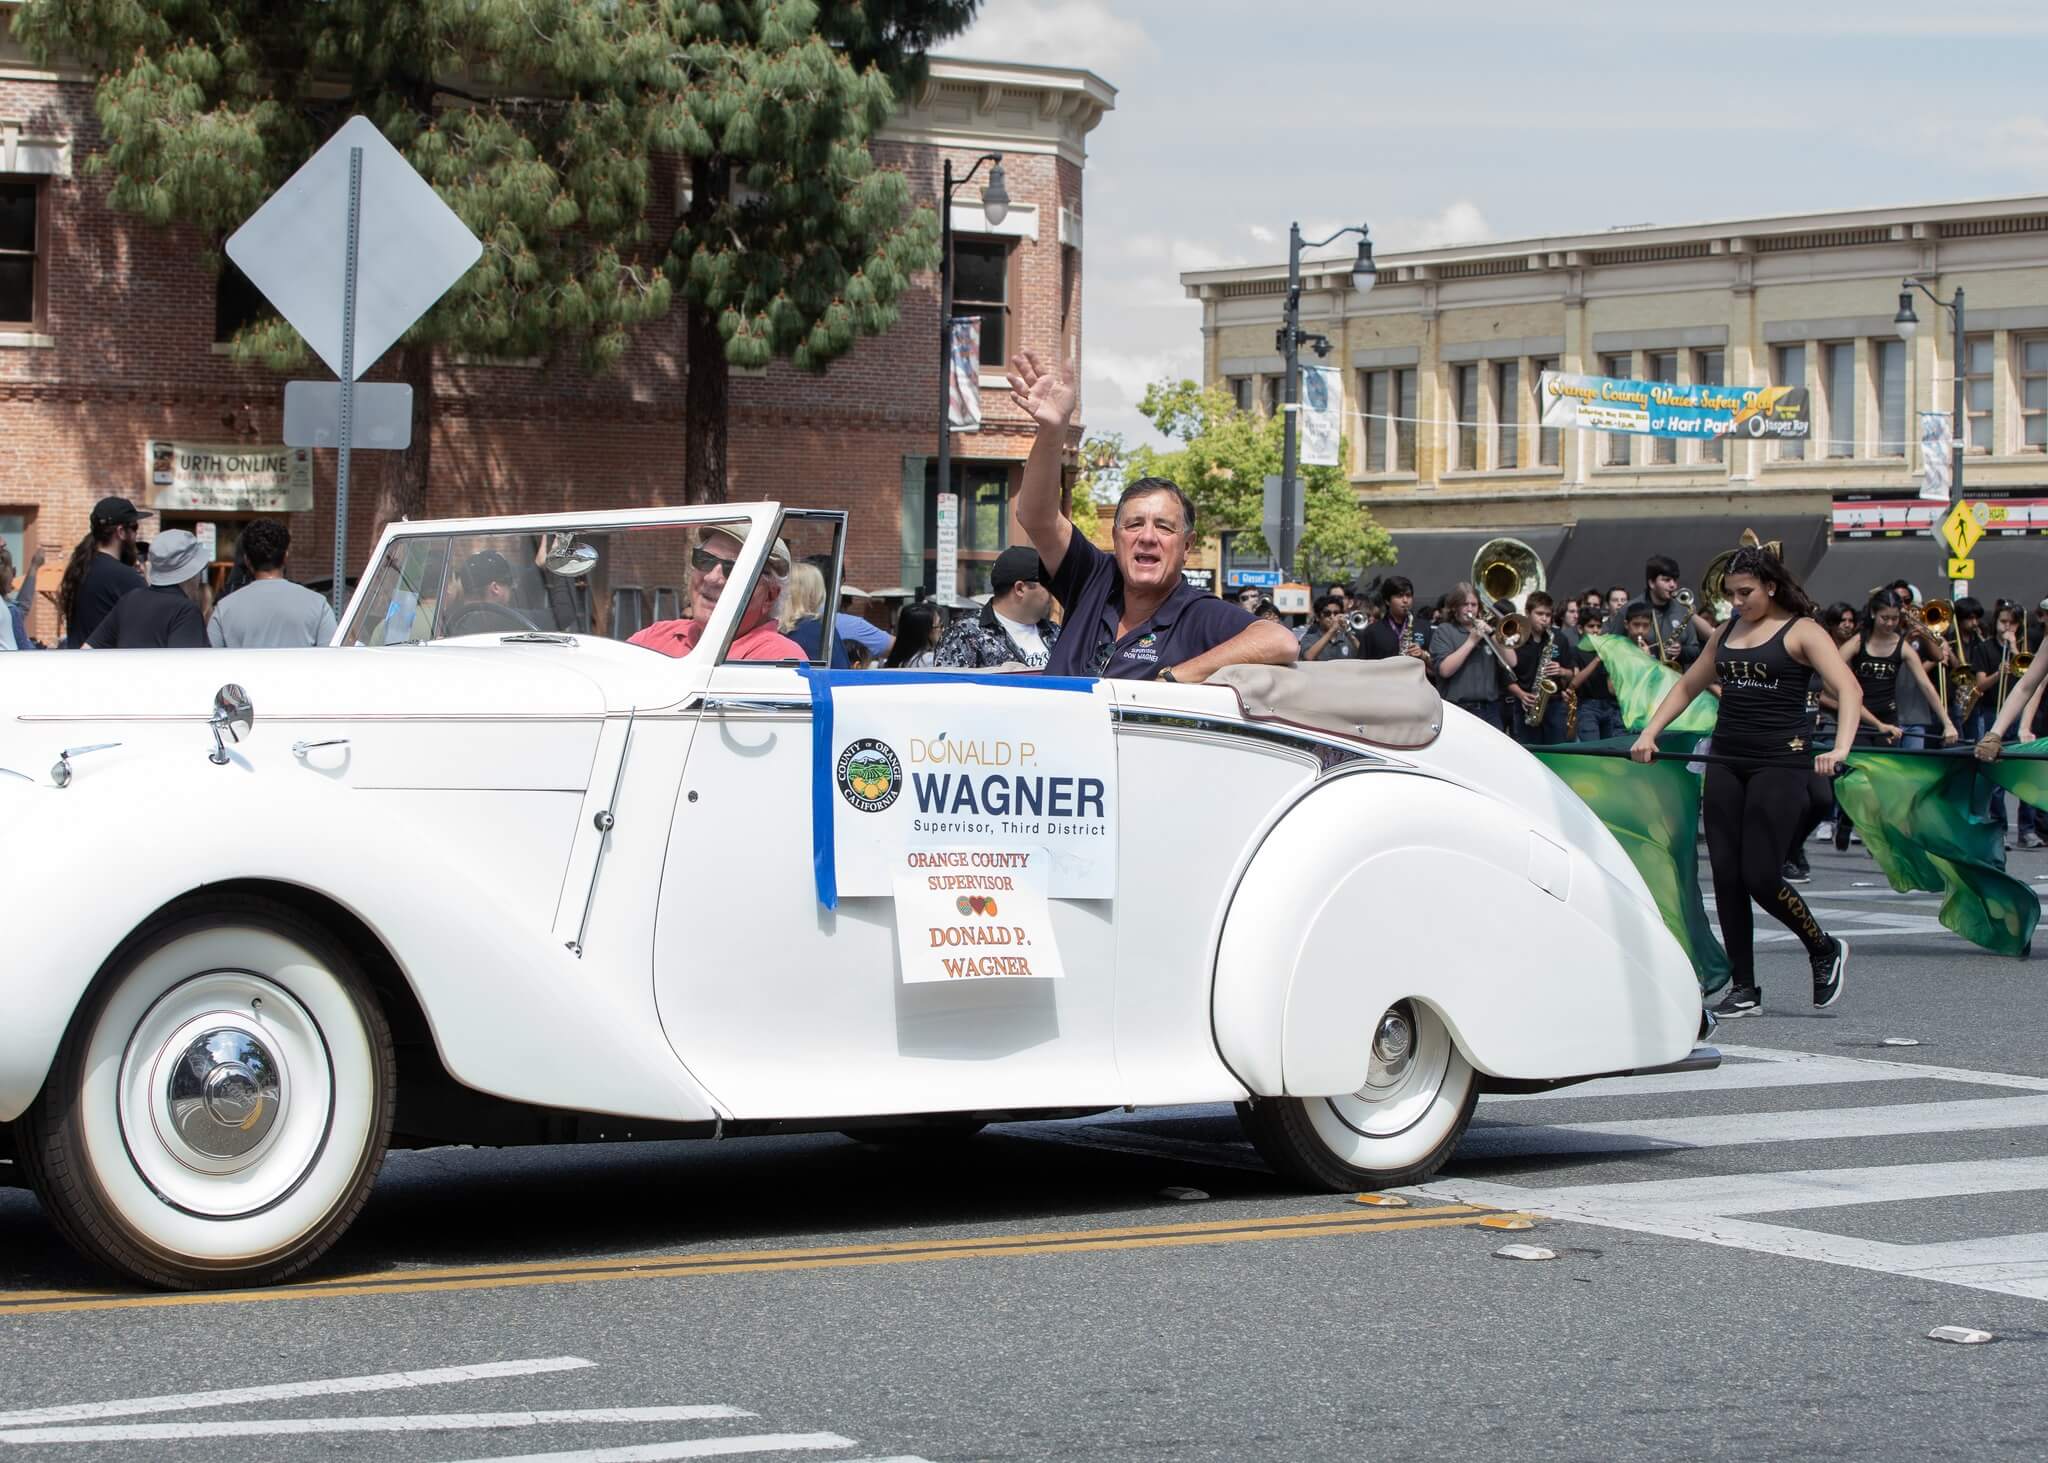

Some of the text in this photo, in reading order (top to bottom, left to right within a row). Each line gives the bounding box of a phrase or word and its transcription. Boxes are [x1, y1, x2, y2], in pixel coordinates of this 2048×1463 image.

[1548, 381, 1776, 416] Orange County Water Safety Day
[1651, 416, 1737, 433] at Hart Park
[180, 455, 288, 472] URTH ONLINE
[838, 742, 861, 781] COUNTY
[875, 742, 901, 780] ORANGE
[910, 738, 1037, 766] DONALD P.
[844, 789, 899, 811] CALIFORNIA
[912, 772, 1104, 817] WAGNER
[914, 819, 1105, 835] Supervisor, Third District
[908, 852, 1030, 868] ORANGE COUNTY
[928, 875, 1014, 891] SUPERVISOR
[929, 926, 1032, 948] DONALD P.
[942, 956, 1032, 978] WAGNER
